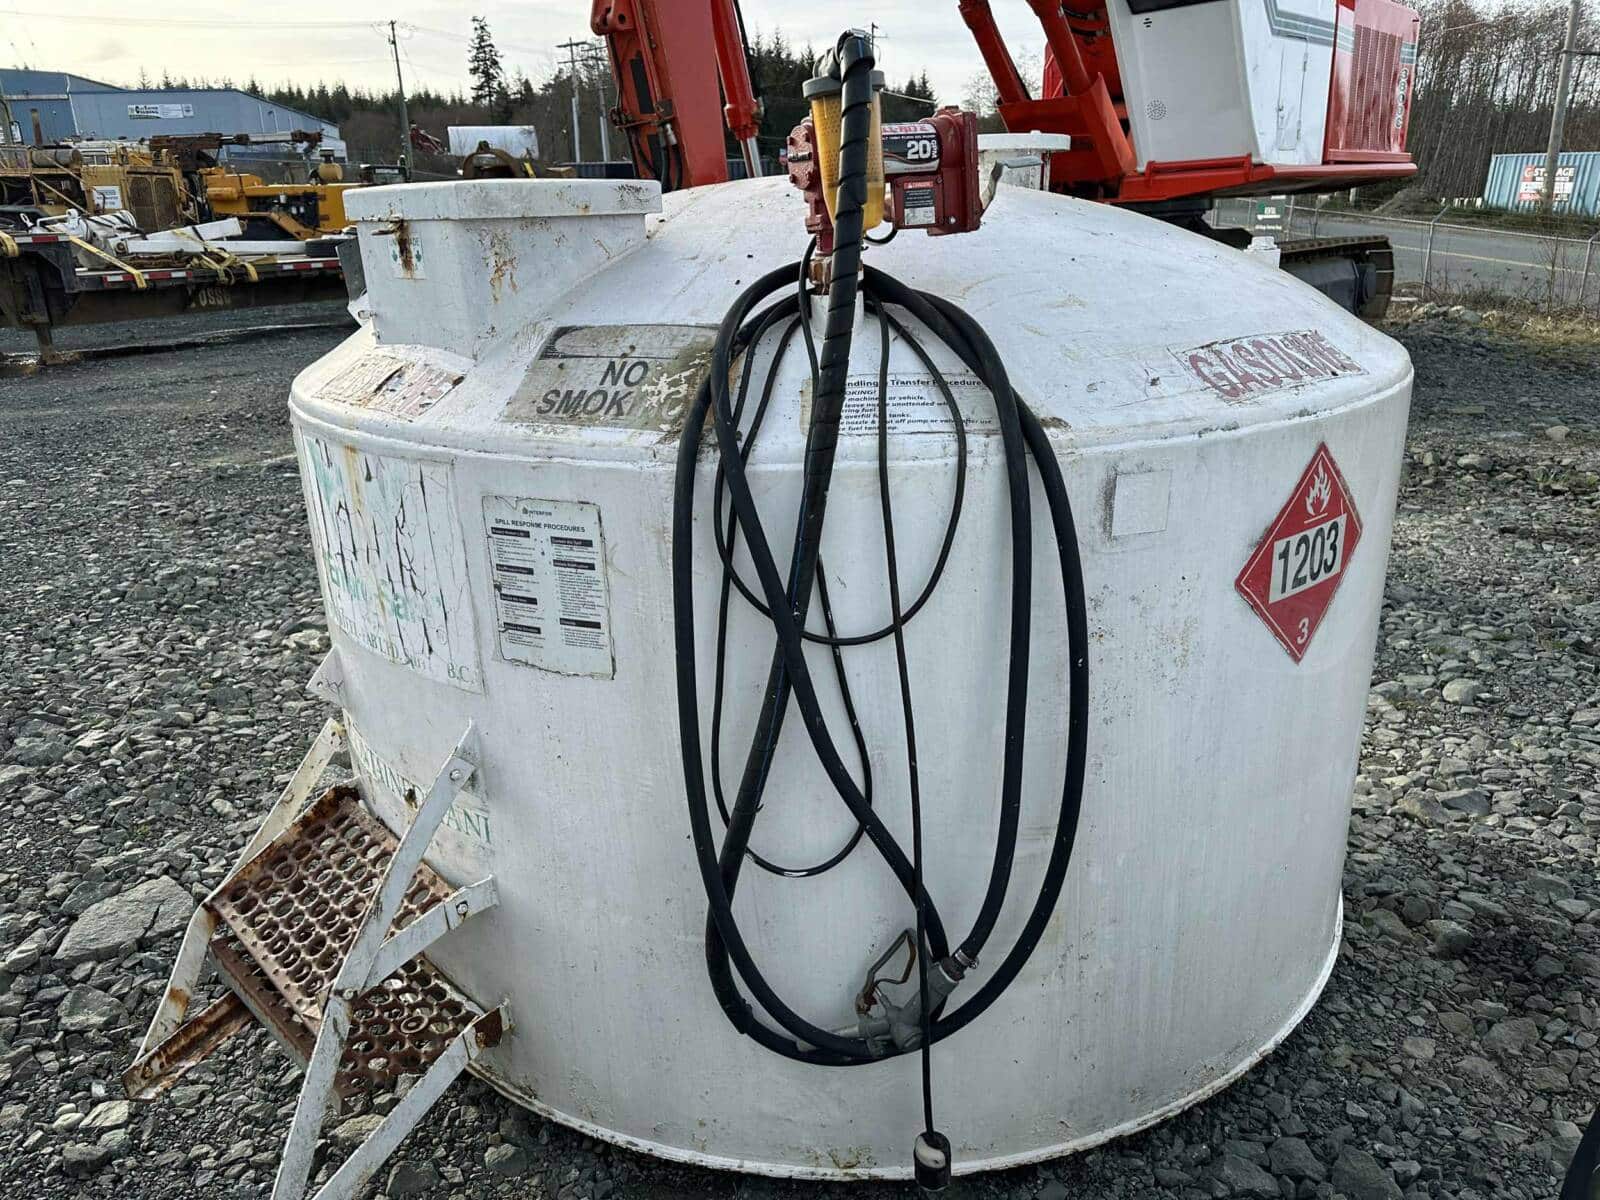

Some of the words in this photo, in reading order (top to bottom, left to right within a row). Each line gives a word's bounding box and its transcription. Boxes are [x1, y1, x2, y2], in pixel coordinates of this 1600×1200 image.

[907, 140, 931, 159] 20
[1534, 167, 1575, 177] STAGE
[599, 360, 649, 387] NO
[847, 380, 879, 388] ndling
[495, 518, 511, 526] SPILL
[511, 520, 543, 529] RESPONSE
[543, 523, 586, 533] PROCEDURES
[1278, 520, 1340, 595] 1203
[1296, 617, 1310, 645] 3
